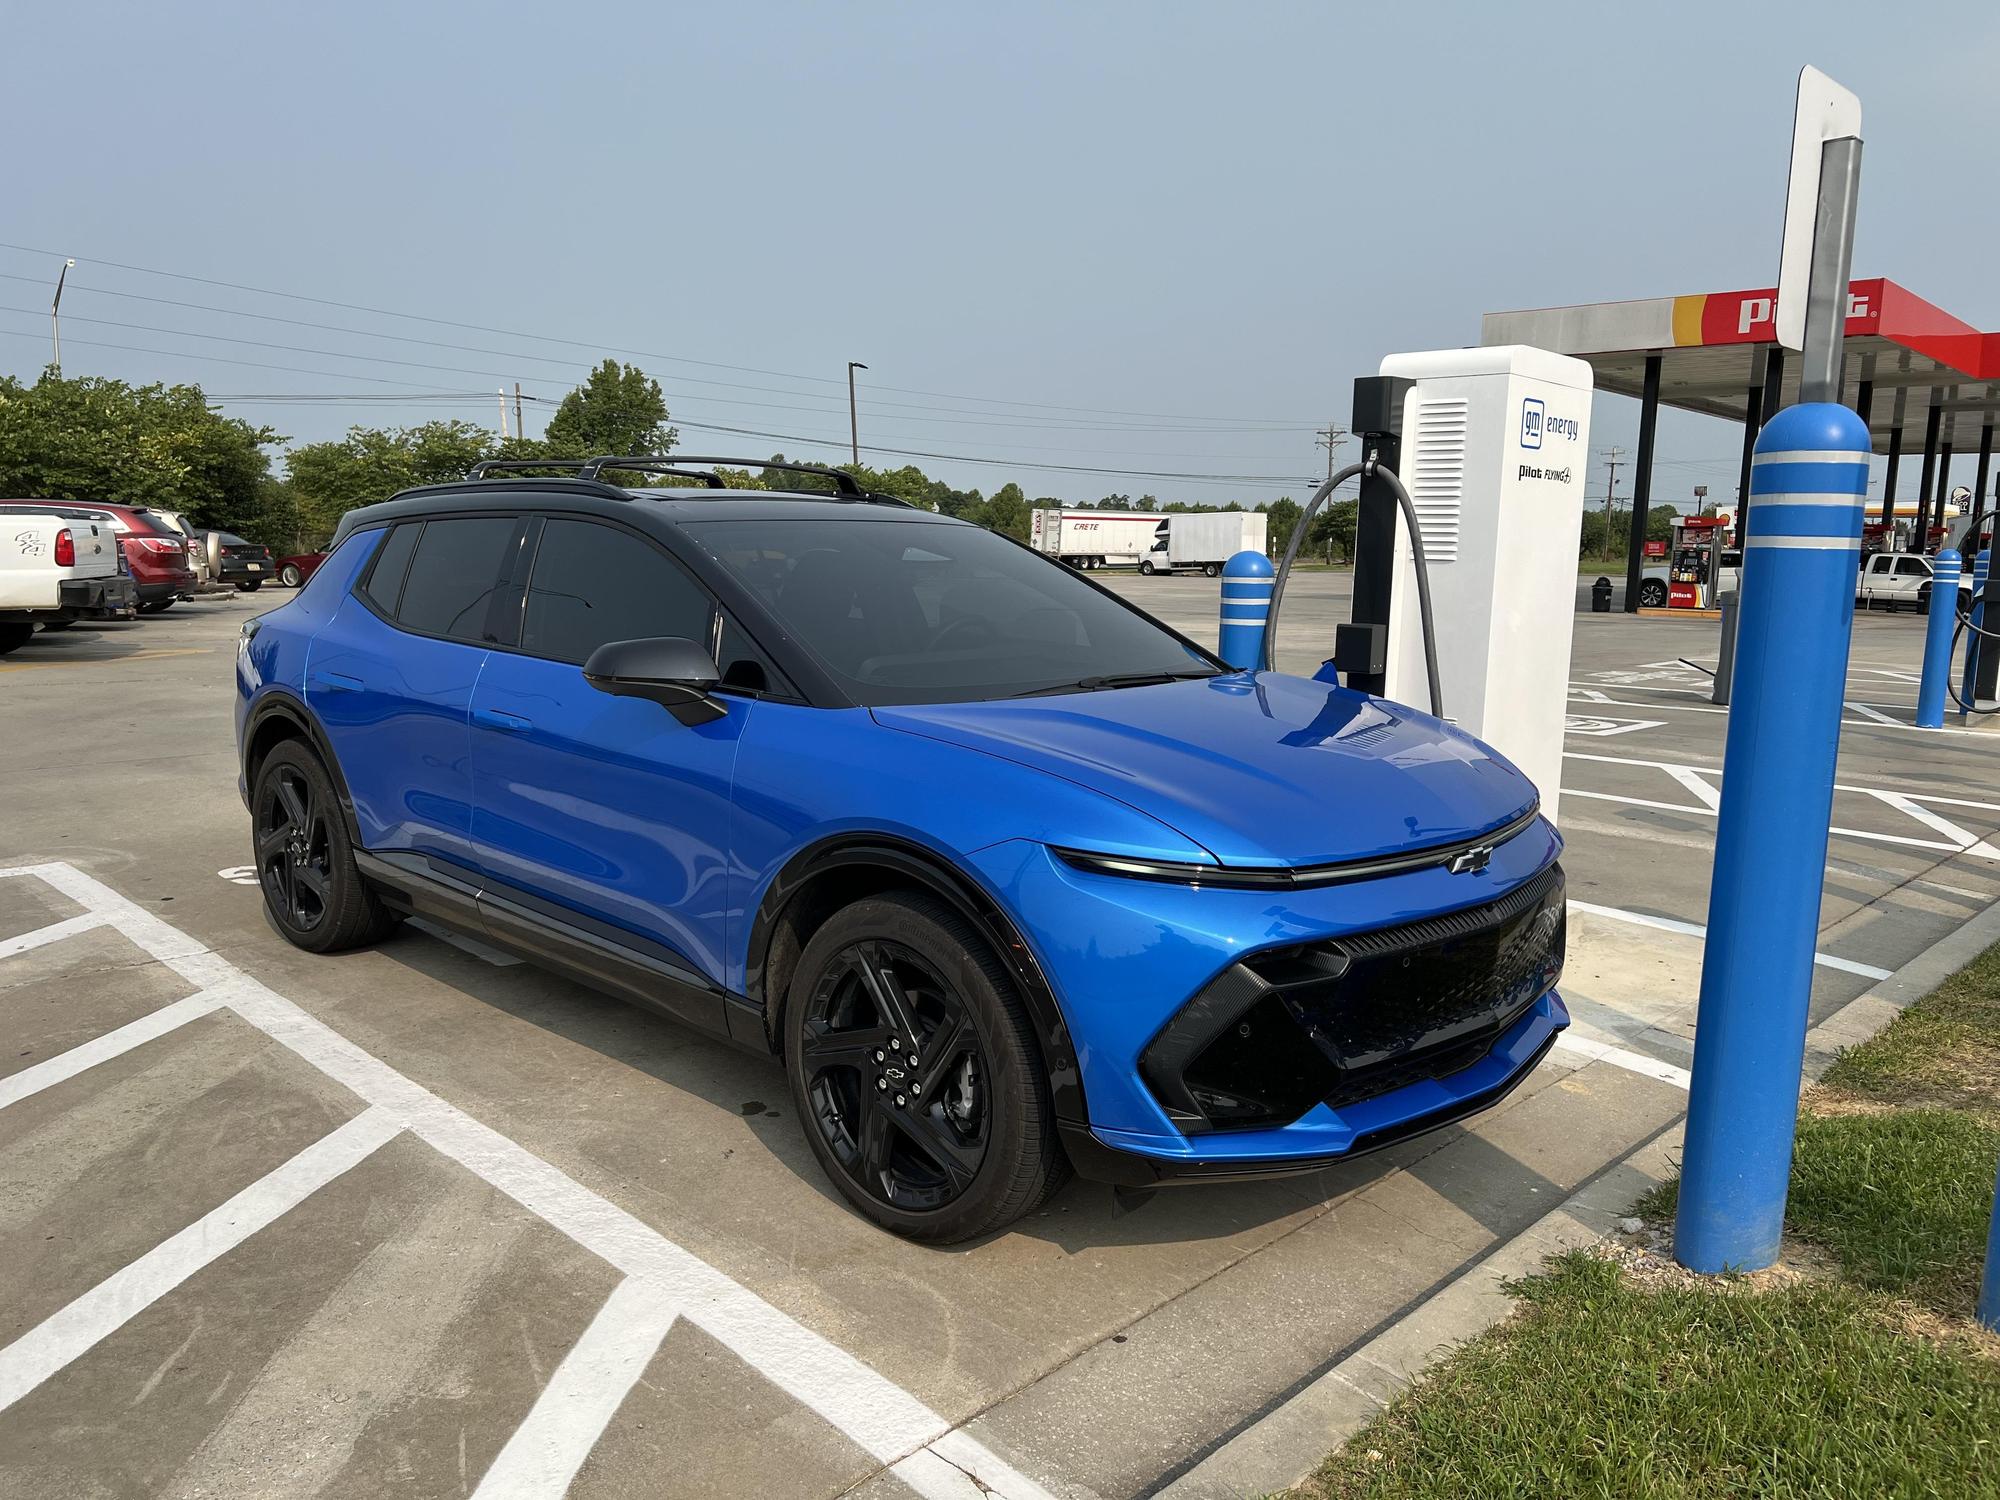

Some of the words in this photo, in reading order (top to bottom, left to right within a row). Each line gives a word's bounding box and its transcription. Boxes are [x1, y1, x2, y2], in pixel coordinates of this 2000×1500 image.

[1526, 411, 1540, 436] gm
[1547, 416, 1578, 441] energy
[1074, 523, 1099, 531] CRETE
